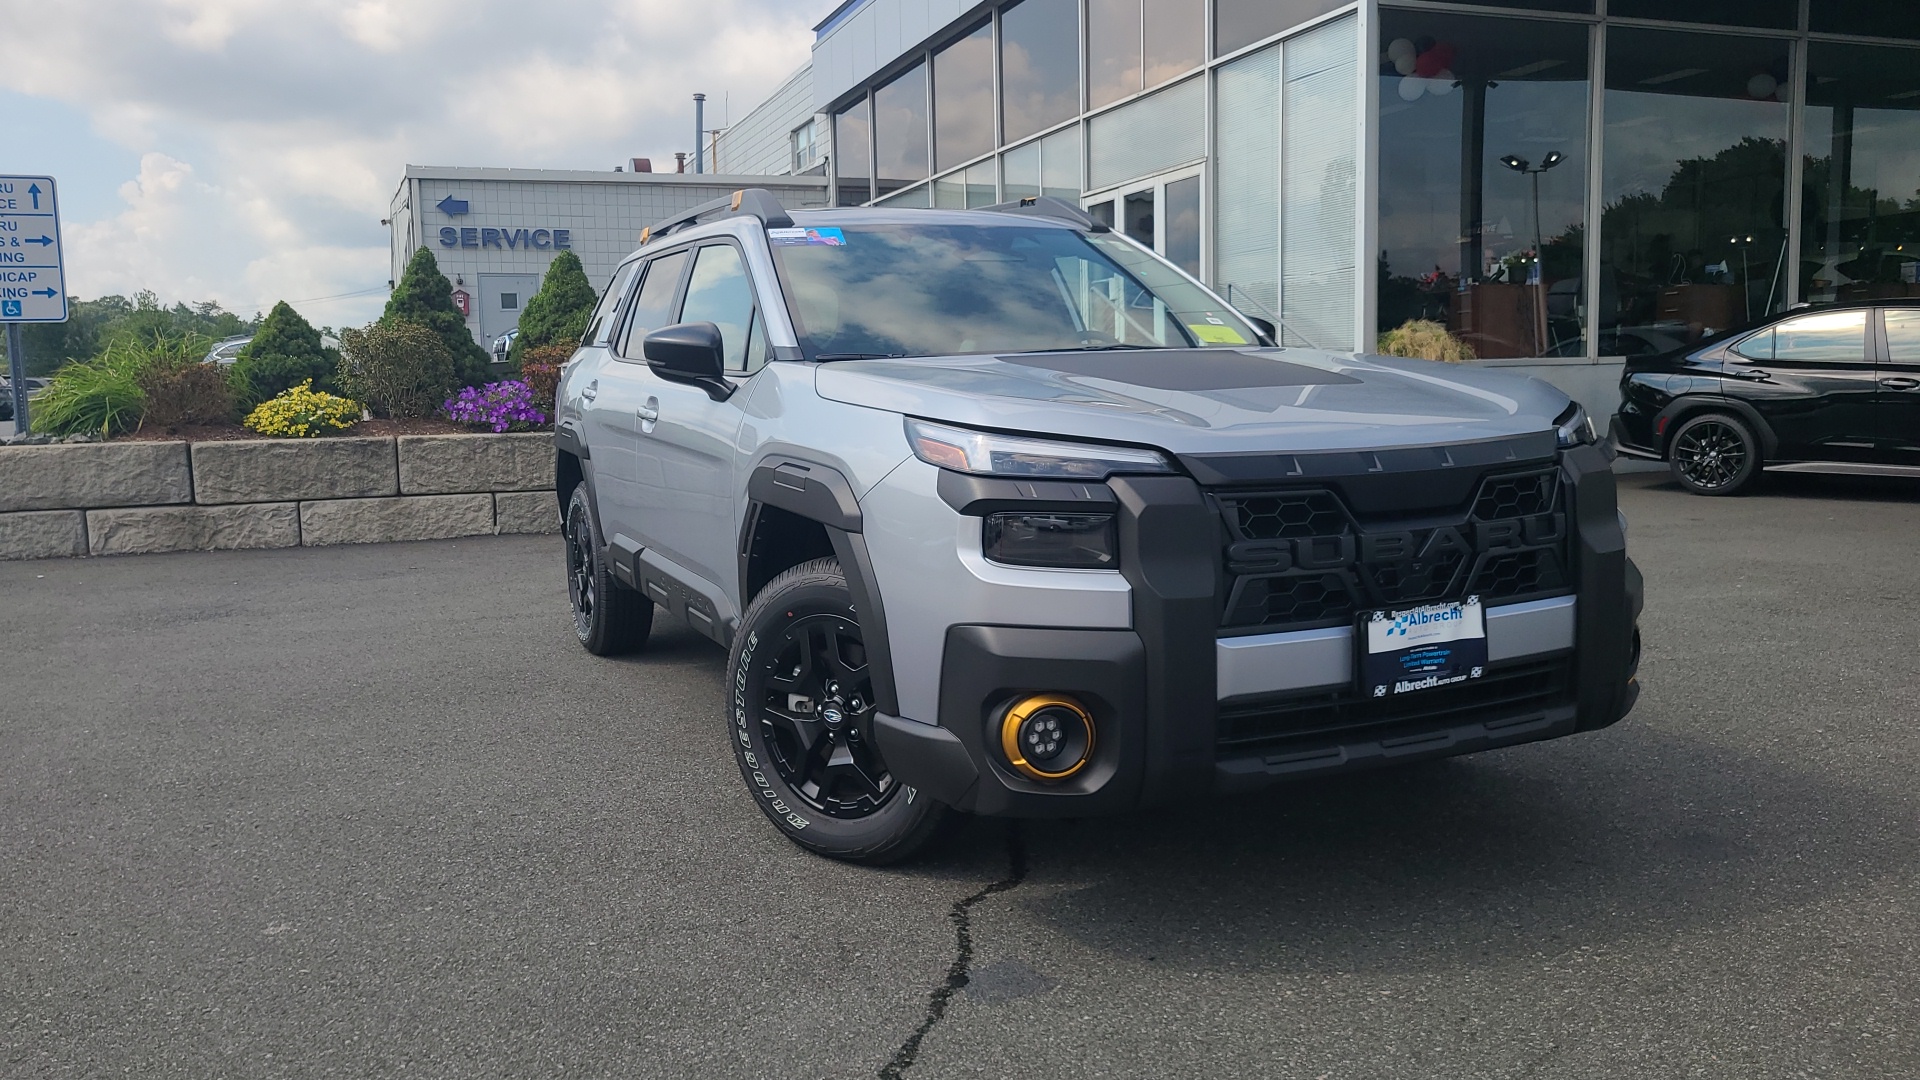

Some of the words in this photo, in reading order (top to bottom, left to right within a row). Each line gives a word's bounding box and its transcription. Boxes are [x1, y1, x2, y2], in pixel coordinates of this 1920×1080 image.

[11, 237, 20, 247] &
[439, 227, 571, 249] SERVICE
[0, 272, 37, 282] ICAP
[0, 288, 28, 298] ING
[1228, 513, 1566, 574] SUBARU
[1409, 608, 1463, 626] Albrecht
[1394, 675, 1438, 694] Albrecht
[735, 630, 811, 831] BRIDGESTONE
